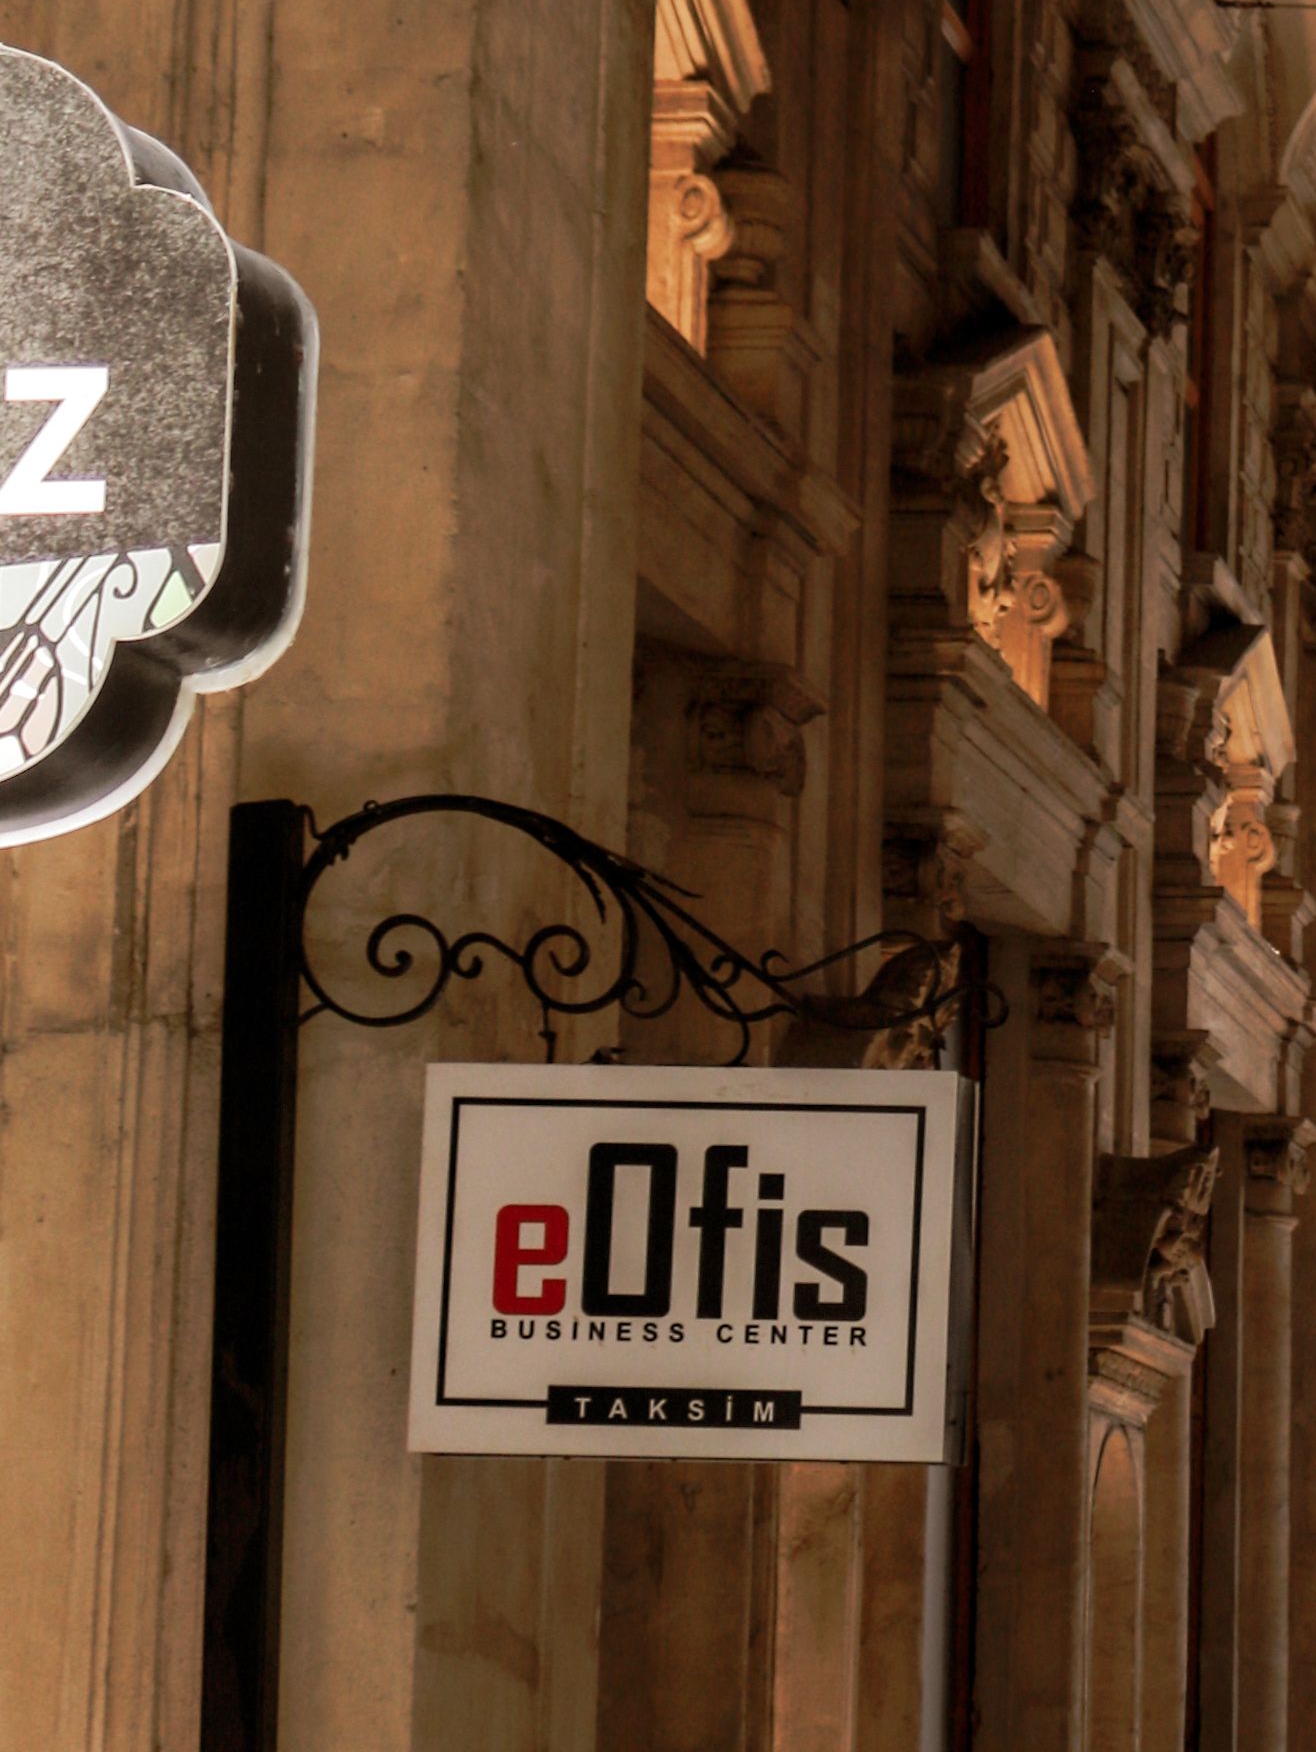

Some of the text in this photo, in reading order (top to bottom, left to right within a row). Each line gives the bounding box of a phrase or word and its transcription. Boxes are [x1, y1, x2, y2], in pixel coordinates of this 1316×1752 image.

[492, 1143, 871, 1322] eOfis
[716, 1324, 869, 1348] CENTER
[574, 1396, 776, 1424] TAKSİM
